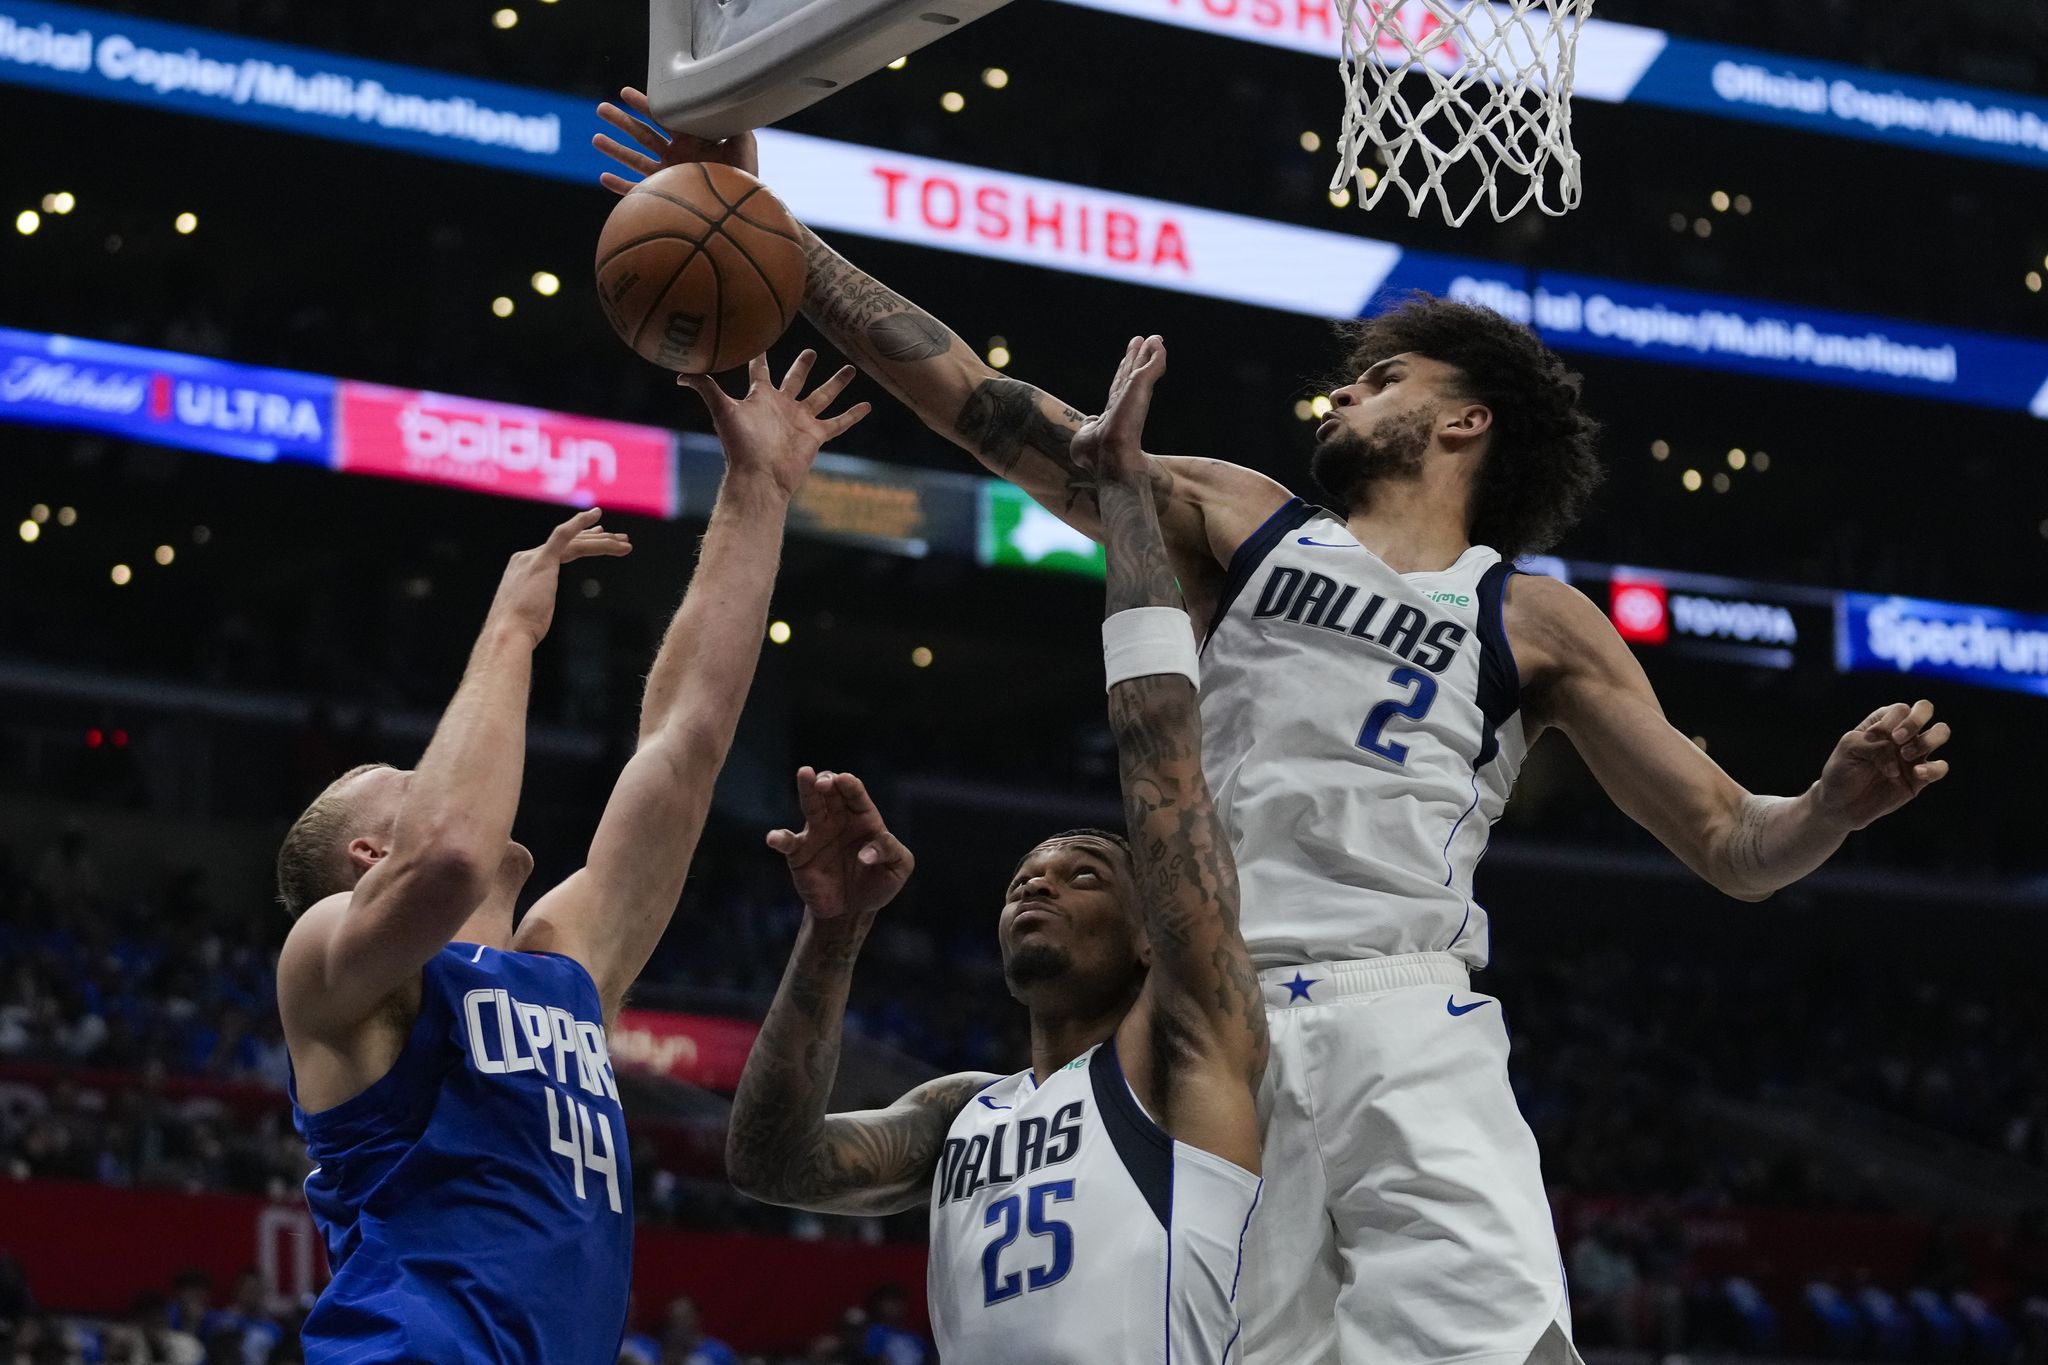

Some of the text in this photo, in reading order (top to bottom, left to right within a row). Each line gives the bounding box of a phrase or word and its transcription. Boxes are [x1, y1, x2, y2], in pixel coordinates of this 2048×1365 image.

[0, 13, 93, 73] icial
[1168, 0, 1464, 60] SHBA
[871, 166, 1193, 273] TOSHIBA
[176, 380, 323, 443] ULTRA
[1251, 564, 1469, 676] DALLAS
[1670, 595, 1798, 647] TOYOTA
[1354, 666, 1439, 767] 2
[463, 988, 622, 1110] CLPPR
[545, 1086, 622, 1214] 44
[938, 1099, 1085, 1209] DALAS
[981, 1178, 1076, 1307] 25
